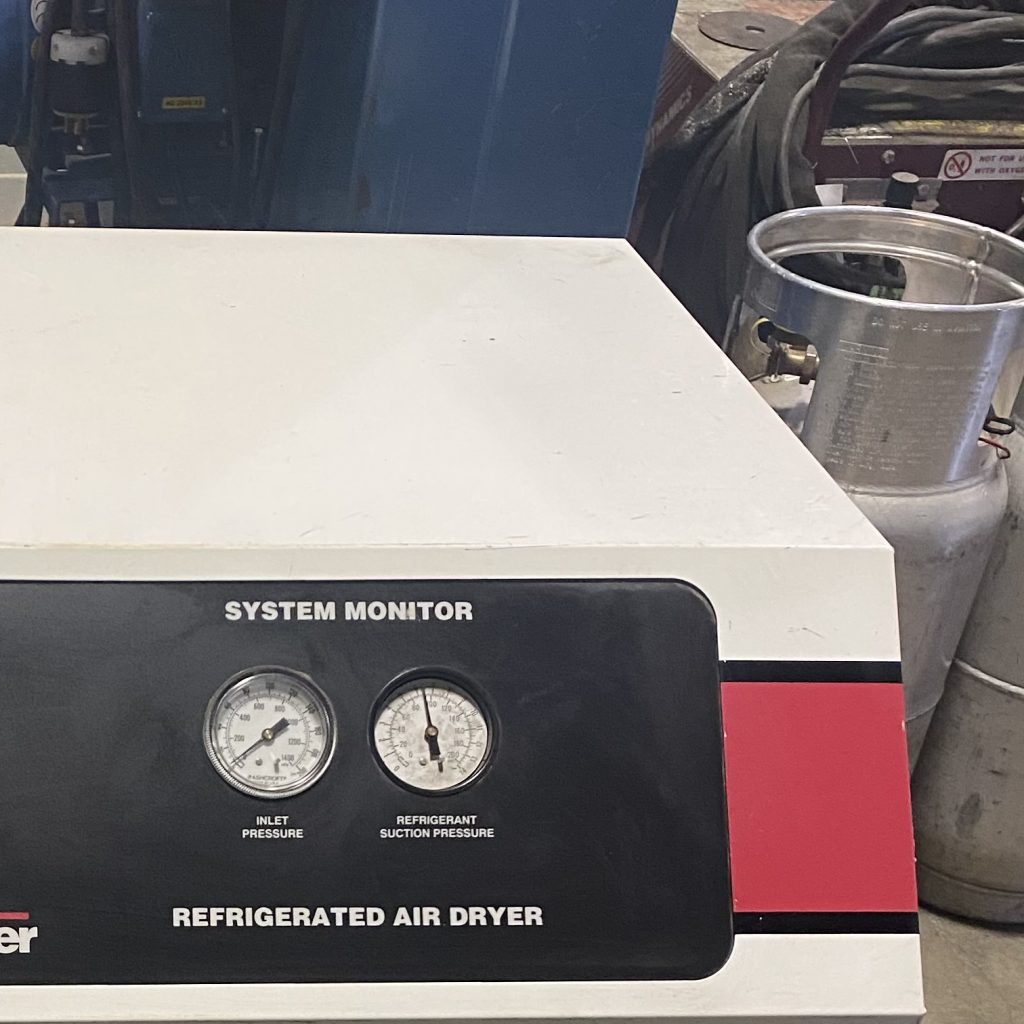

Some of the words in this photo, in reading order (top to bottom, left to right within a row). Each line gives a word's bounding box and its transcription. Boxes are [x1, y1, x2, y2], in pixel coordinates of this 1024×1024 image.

[225, 601, 336, 621] SYSTEM
[344, 601, 473, 621] MONITOR
[256, 815, 289, 826] INLET
[396, 815, 478, 825] REFRIGERANT
[241, 828, 304, 839] PRESSURE
[379, 828, 431, 839] SUCTION
[432, 828, 495, 838] PRESSURE
[172, 907, 387, 927] REFRIGERATED
[392, 907, 441, 926] AIR
[448, 907, 544, 926] DRYER
